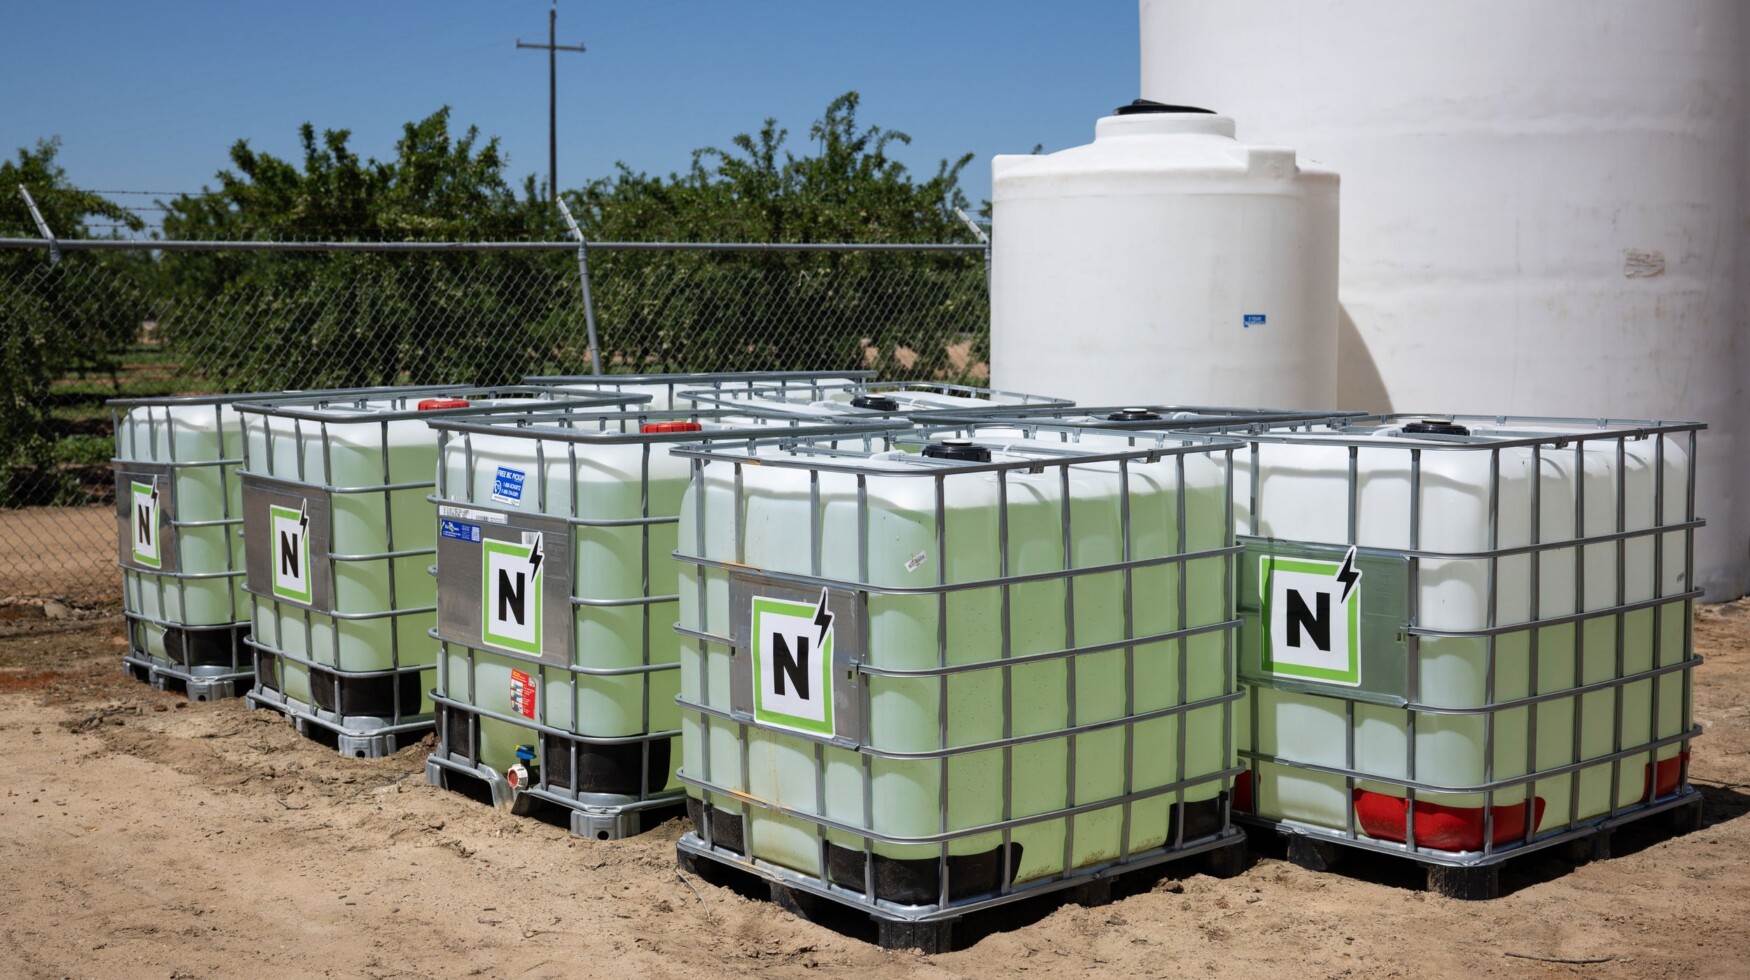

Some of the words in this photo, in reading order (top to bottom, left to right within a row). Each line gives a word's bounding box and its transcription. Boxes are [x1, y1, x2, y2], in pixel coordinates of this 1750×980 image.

[138, 504, 151, 546] N
[281, 531, 298, 579] N
[499, 568, 526, 626] N
[1286, 589, 1331, 652] N
[772, 632, 810, 701] N
